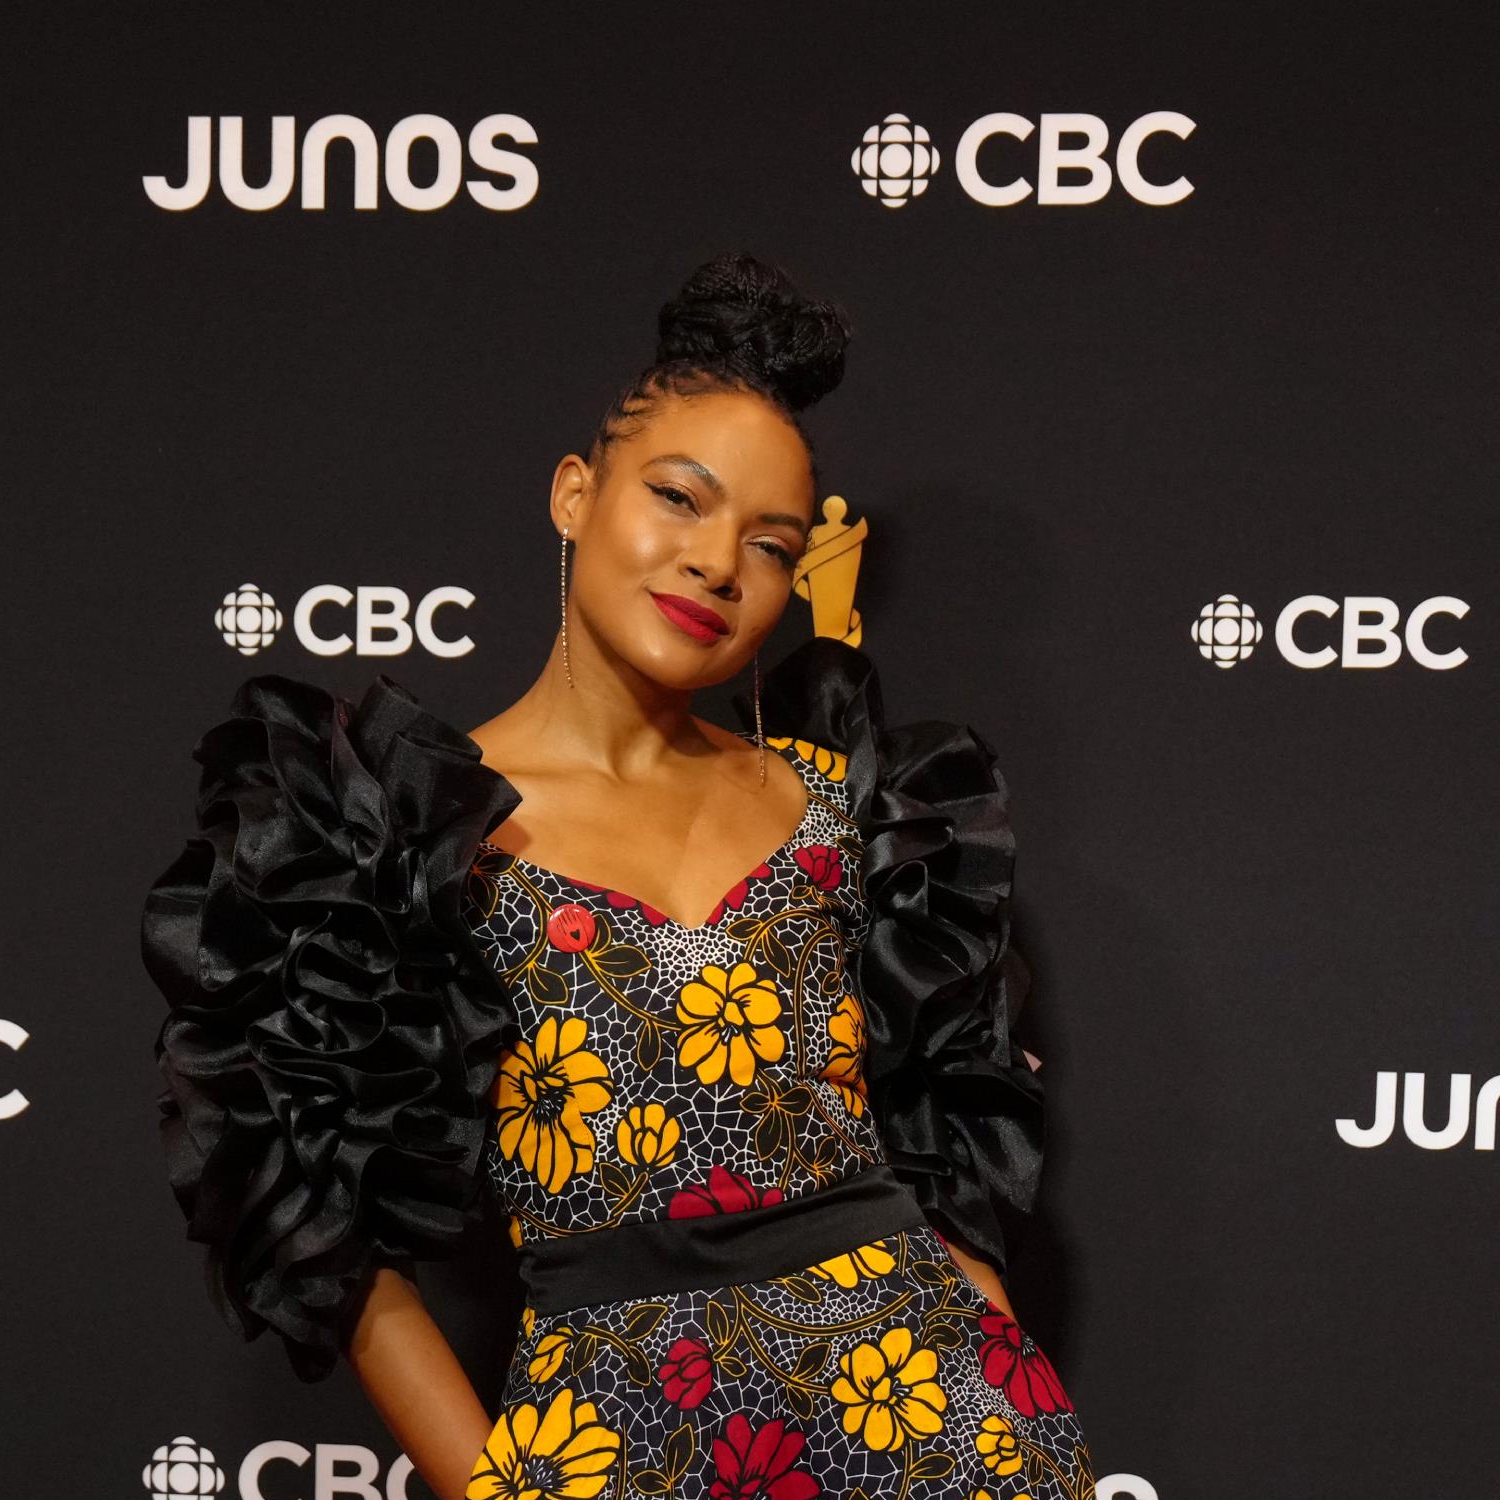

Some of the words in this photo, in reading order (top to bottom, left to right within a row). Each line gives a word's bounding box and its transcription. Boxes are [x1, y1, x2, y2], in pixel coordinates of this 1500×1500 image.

[142, 113, 539, 212] JUNOS
[955, 110, 1197, 207] CBC
[293, 584, 476, 658] CBC
[1275, 594, 1471, 670] CBC
